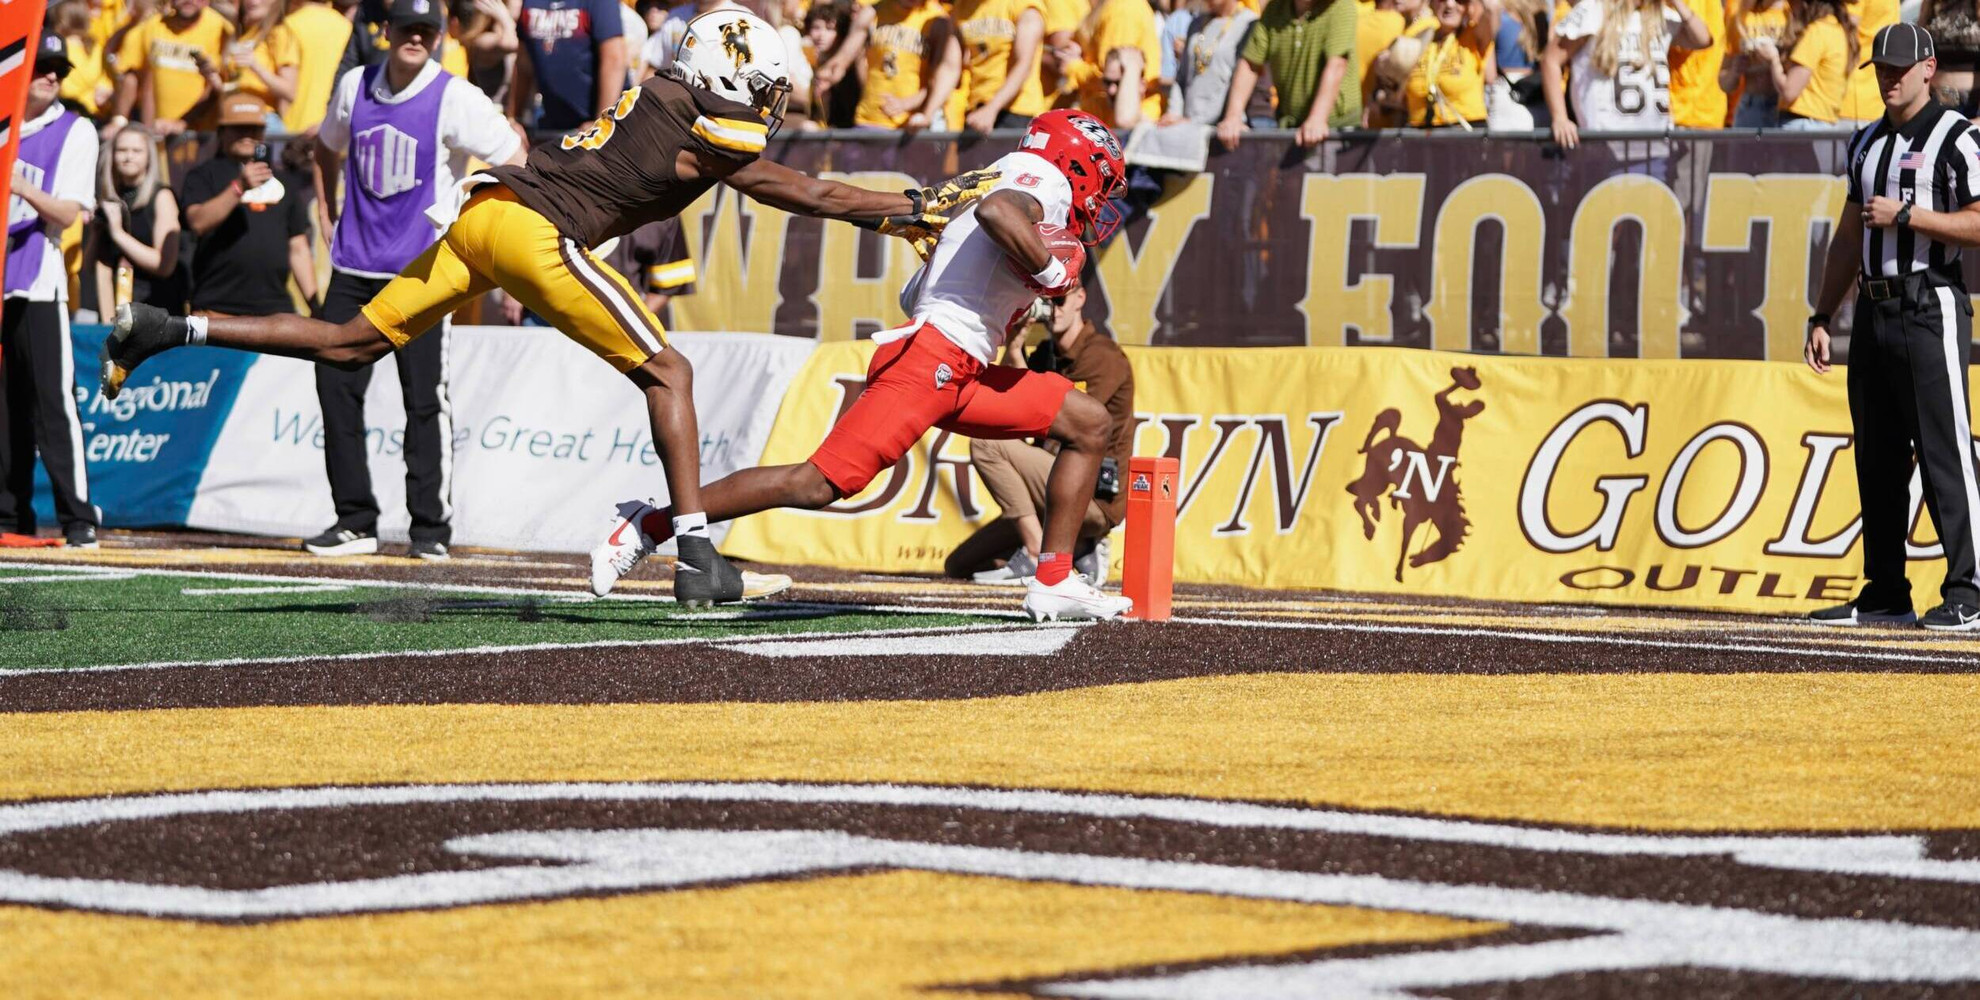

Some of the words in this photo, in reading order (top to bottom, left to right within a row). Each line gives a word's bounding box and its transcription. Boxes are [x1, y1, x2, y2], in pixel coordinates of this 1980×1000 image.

[481, 415, 594, 461] Great
[608, 427, 730, 466] Heth
[1559, 564, 1858, 601] OUTLE
